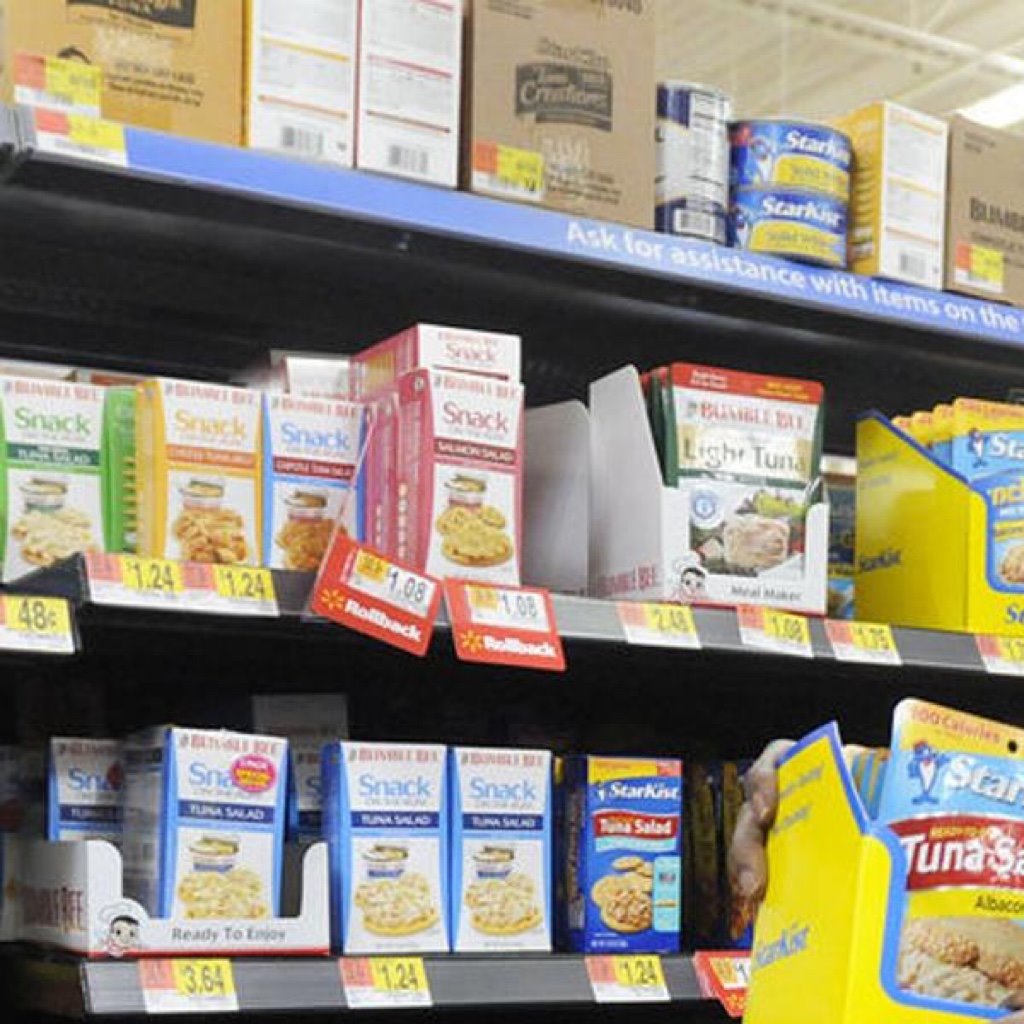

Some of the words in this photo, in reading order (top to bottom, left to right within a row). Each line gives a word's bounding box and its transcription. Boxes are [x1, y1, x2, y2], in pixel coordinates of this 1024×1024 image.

[567, 221, 616, 250] Ask
[624, 231, 662, 260] for
[670, 247, 806, 288] assistance
[811, 273, 866, 300] with
[872, 281, 940, 315] items
[944, 302, 976, 322] on
[980, 302, 1019, 332] the
[445, 340, 496, 363] Snack
[14, 406, 92, 436] Snack
[176, 410, 246, 437] Snack
[442, 401, 509, 434] Snack
[700, 399, 769, 428] BUMBLE
[775, 409, 806, 430] BEE
[280, 422, 350, 450] Snack
[682, 435, 746, 470] Light
[753, 443, 806, 473] Tuna
[133, 560, 175, 591] 1.24
[226, 571, 266, 598] 1.24
[390, 566, 428, 604] 1.08
[501, 592, 539, 618] 1.08
[344, 599, 423, 642] Rollback
[481, 633, 558, 657] Rollback
[188, 762, 232, 788] Sna
[358, 772, 431, 797] Snack
[470, 776, 537, 801] Snack
[608, 780, 680, 800] StarKist
[189, 804, 222, 817] TUNA
[225, 807, 265, 820] SALAD
[600, 818, 632, 835] Tuna
[634, 816, 672, 835] Salad
[900, 833, 985, 873] Tuna
[171, 927, 219, 944] Ready
[224, 927, 243, 941] To
[247, 927, 287, 945] Enjoy
[184, 966, 226, 993] 3.64
[381, 962, 419, 991] 1.24
